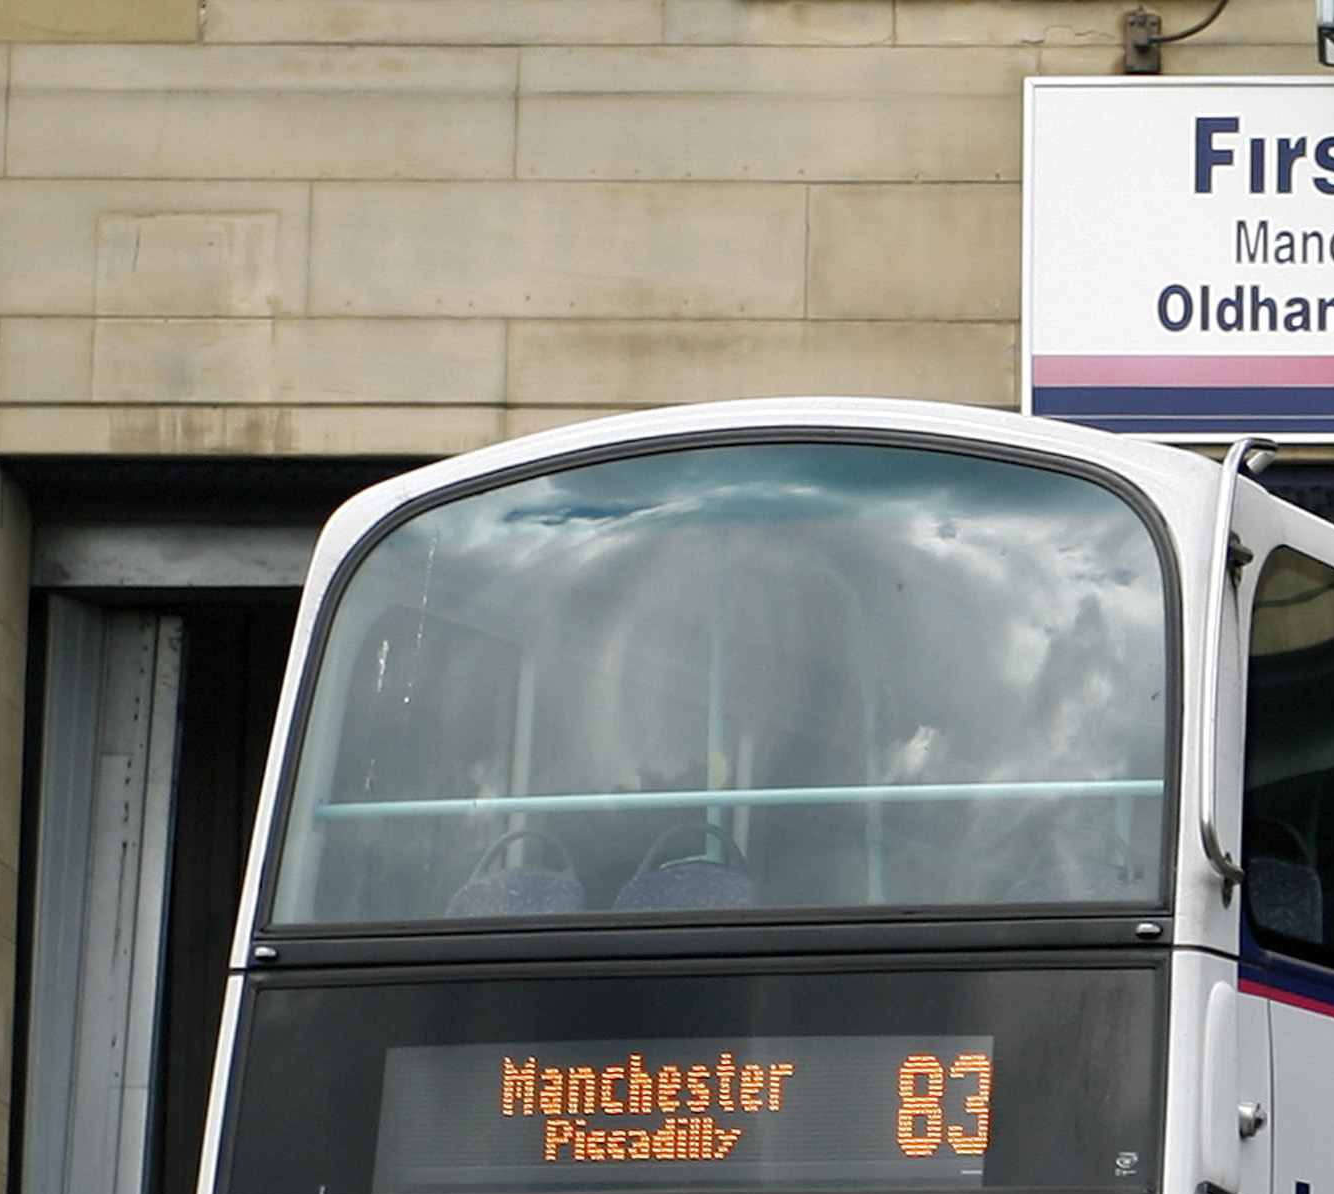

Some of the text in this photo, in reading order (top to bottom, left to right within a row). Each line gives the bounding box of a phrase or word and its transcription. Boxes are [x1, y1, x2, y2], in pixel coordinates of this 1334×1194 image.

[500, 1051, 993, 1158] Manchester 83
[543, 1115, 746, 1163] Piccadilly
